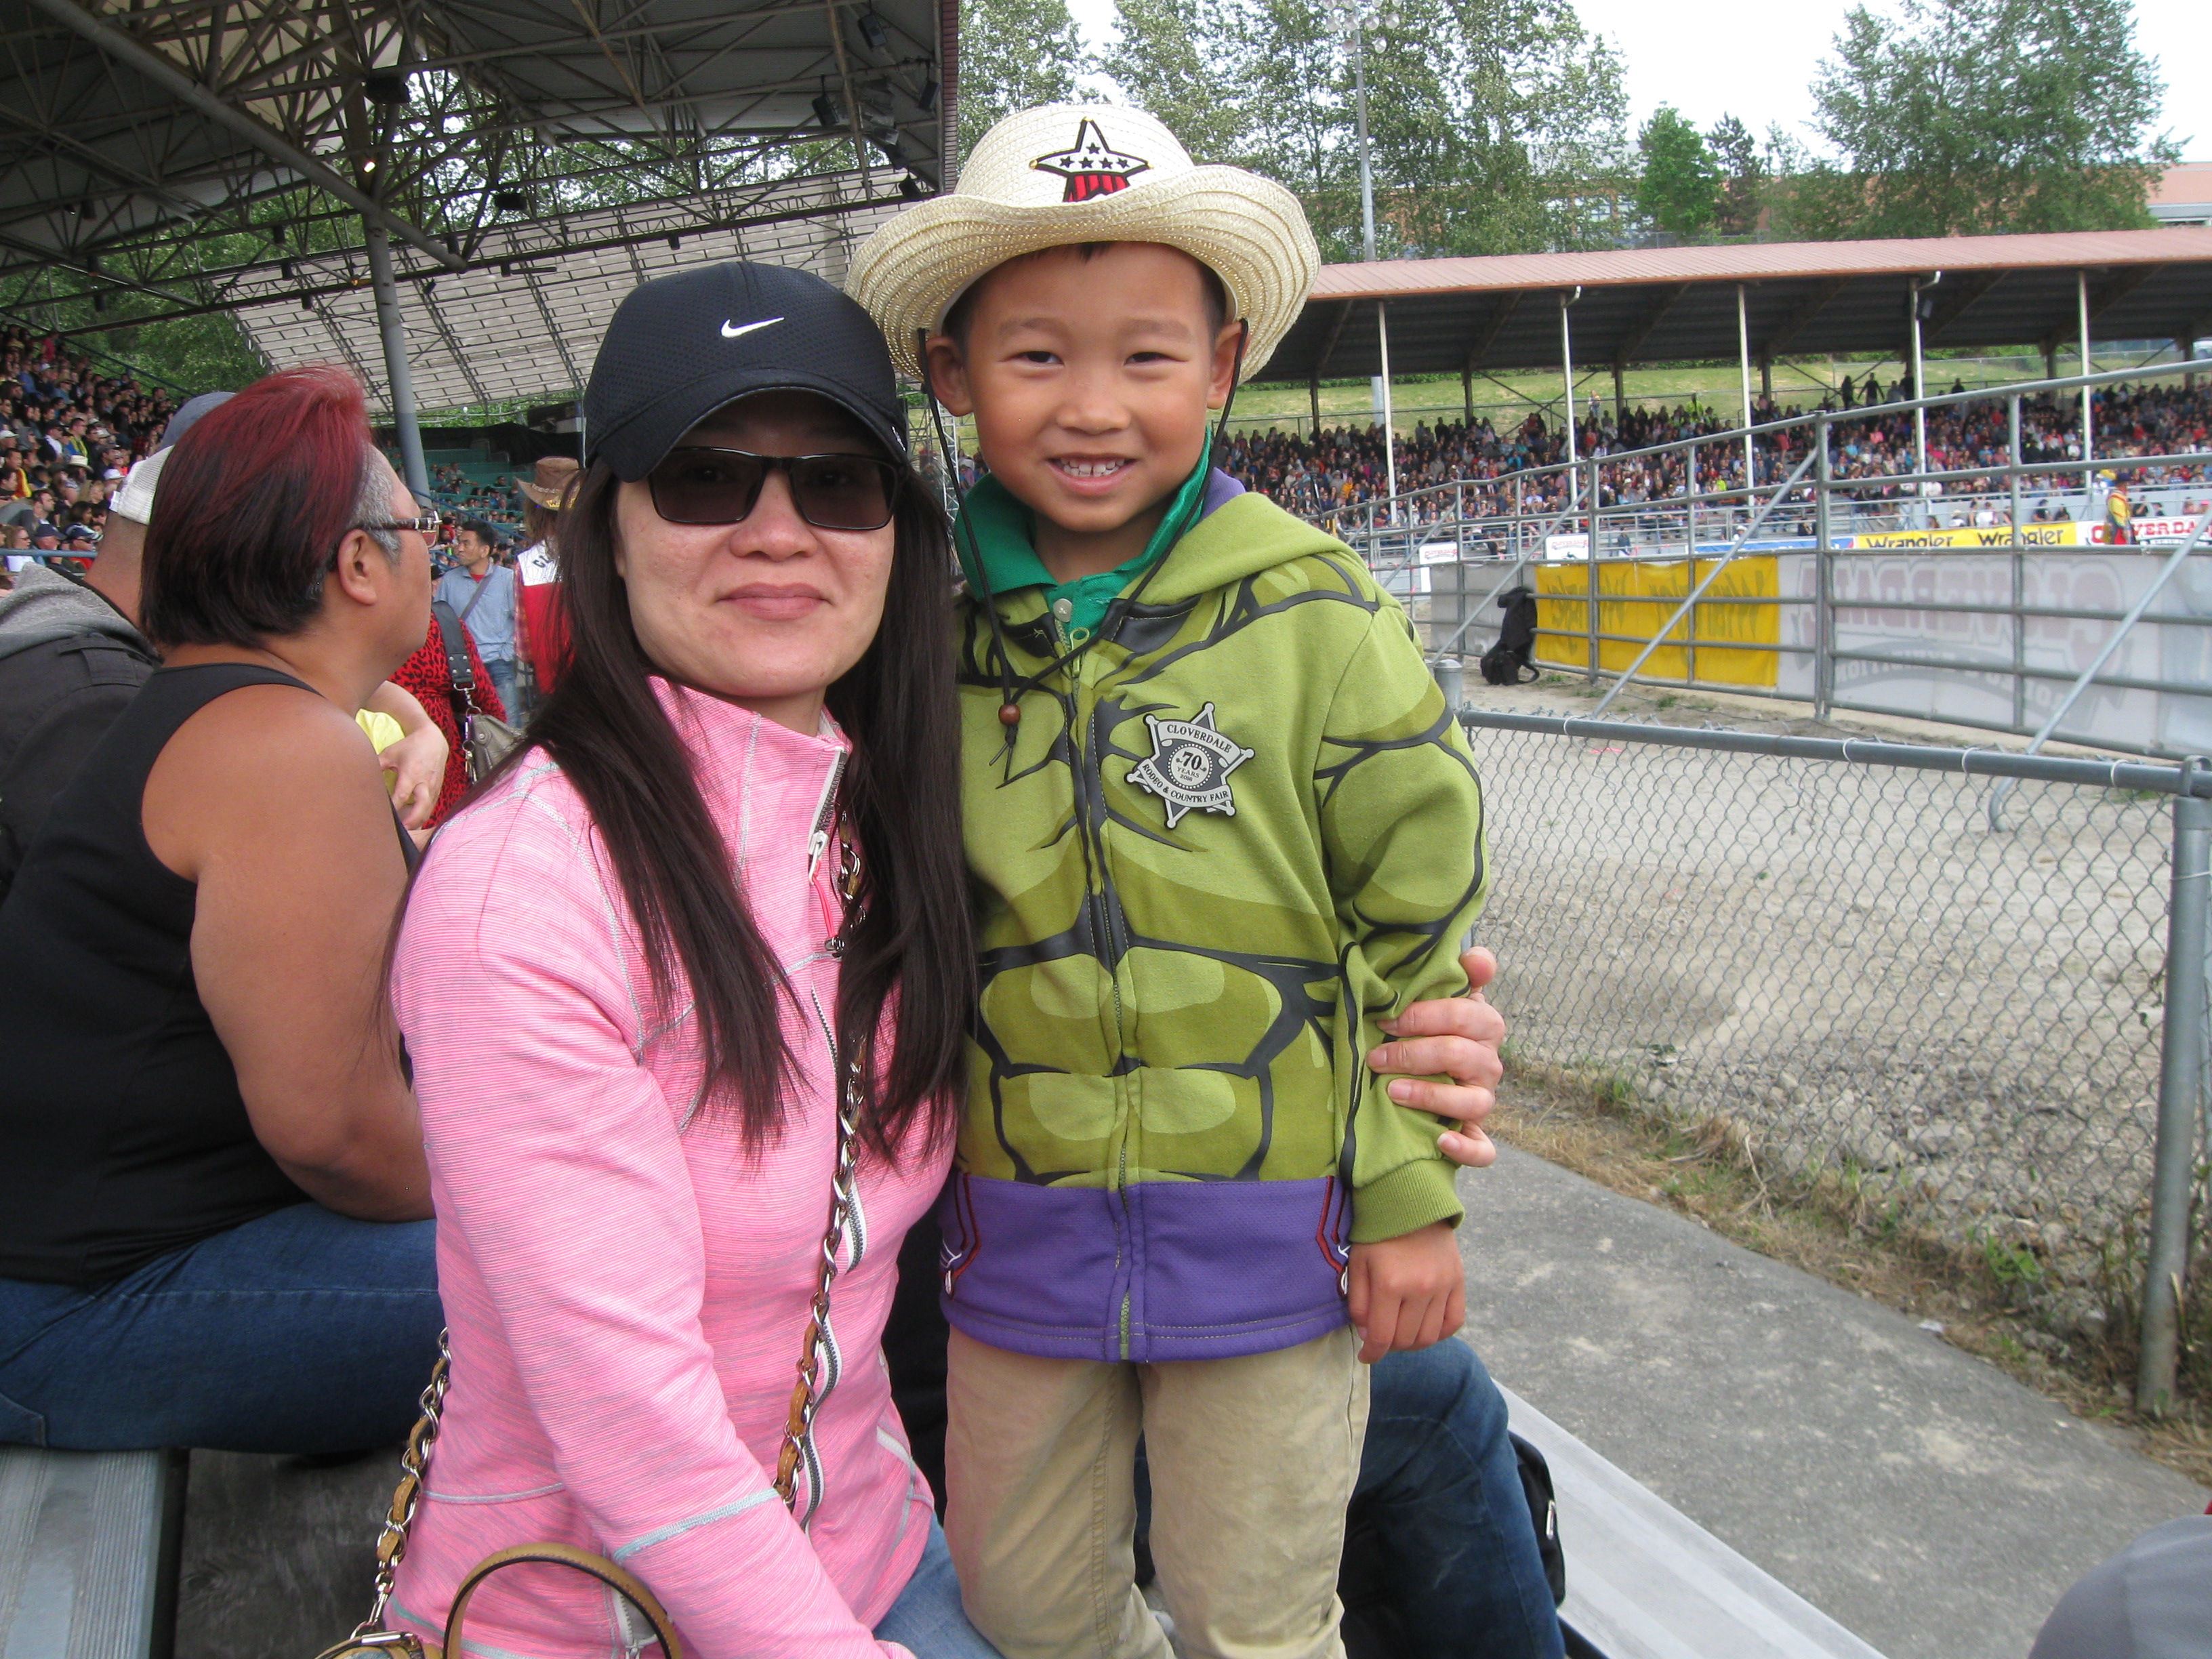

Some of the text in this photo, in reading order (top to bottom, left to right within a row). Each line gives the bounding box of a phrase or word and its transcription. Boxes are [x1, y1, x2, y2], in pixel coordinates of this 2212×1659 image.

[1866, 533, 1953, 548] Wrangler
[1166, 724, 1233, 753] CLOVERDALE
[1182, 751, 1202, 771] 70
[1176, 766, 1200, 778] YEARS
[1143, 764, 1229, 803] RODEO & COUNTRY FAIR
